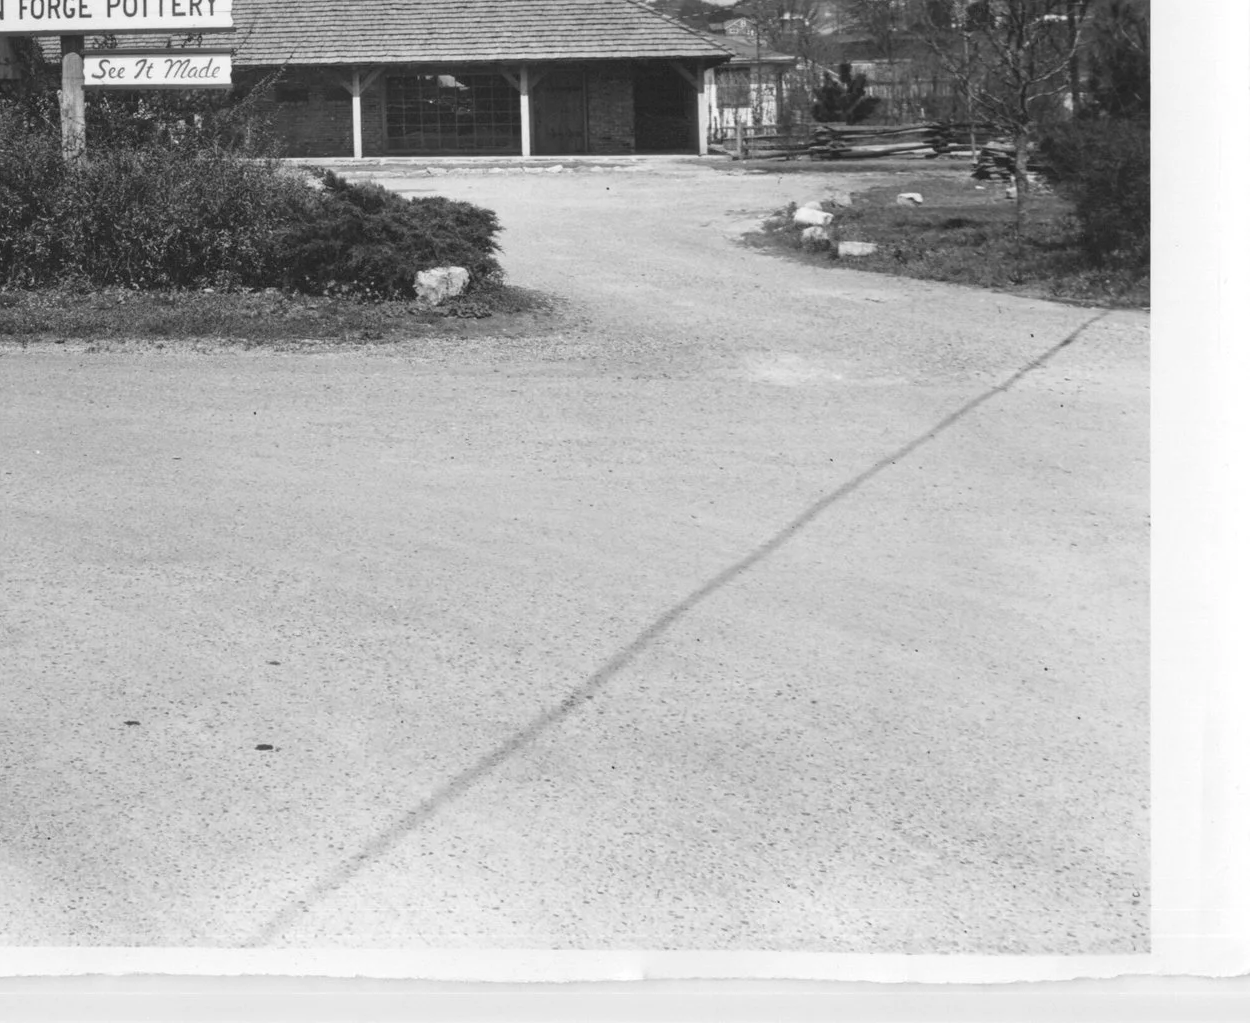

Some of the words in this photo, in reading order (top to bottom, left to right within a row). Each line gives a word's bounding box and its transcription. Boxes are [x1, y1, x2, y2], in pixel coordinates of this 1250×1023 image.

[91, 58, 126, 79] See
[133, 58, 154, 79] It
[163, 57, 221, 79] Made
